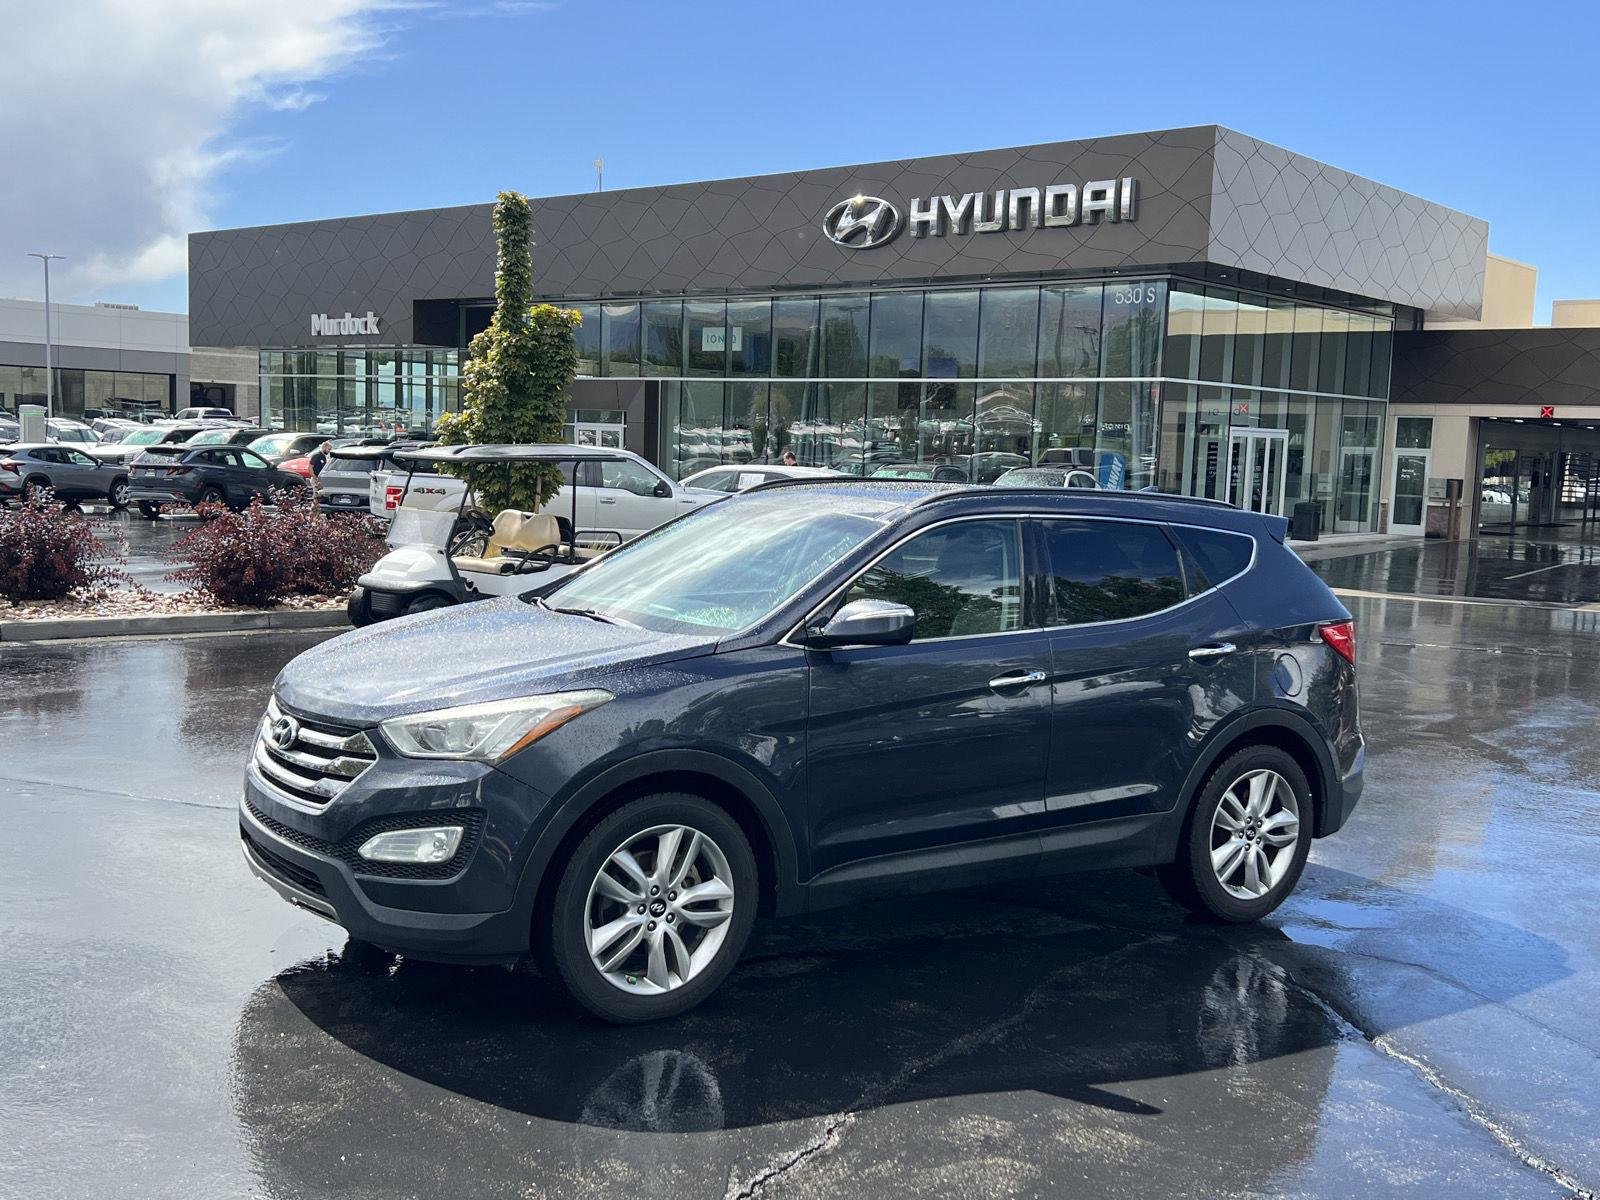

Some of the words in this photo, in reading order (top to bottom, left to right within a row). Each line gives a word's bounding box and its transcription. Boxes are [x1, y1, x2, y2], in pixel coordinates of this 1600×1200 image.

[910, 176, 1135, 238] HYUNDAI
[1115, 287, 1142, 304] 530
[1146, 286, 1156, 304] S
[311, 311, 380, 336] Murdock
